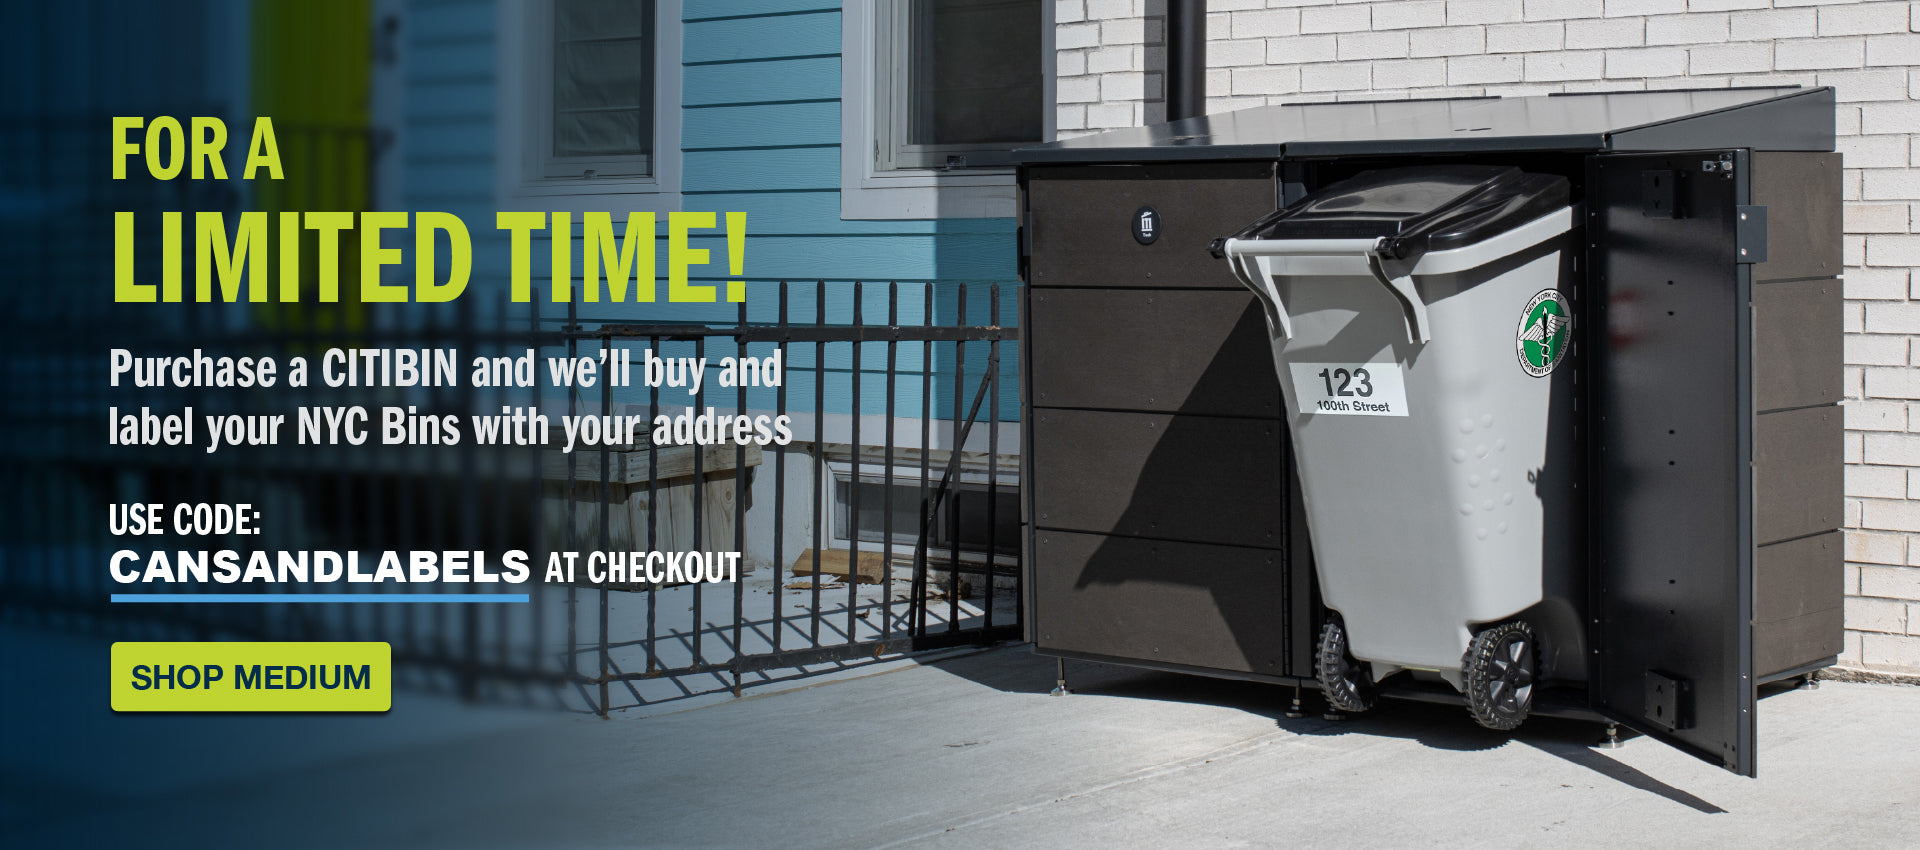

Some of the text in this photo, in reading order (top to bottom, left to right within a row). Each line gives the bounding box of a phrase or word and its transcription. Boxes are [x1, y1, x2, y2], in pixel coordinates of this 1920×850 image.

[1526, 301, 1537, 316] NEW
[1537, 292, 1551, 304] YORK
[1519, 348, 1545, 375] DEPARTMENT
[1544, 364, 1552, 373] OF
[1318, 367, 1374, 398] 123
[1316, 400, 1391, 412] 100th Street
